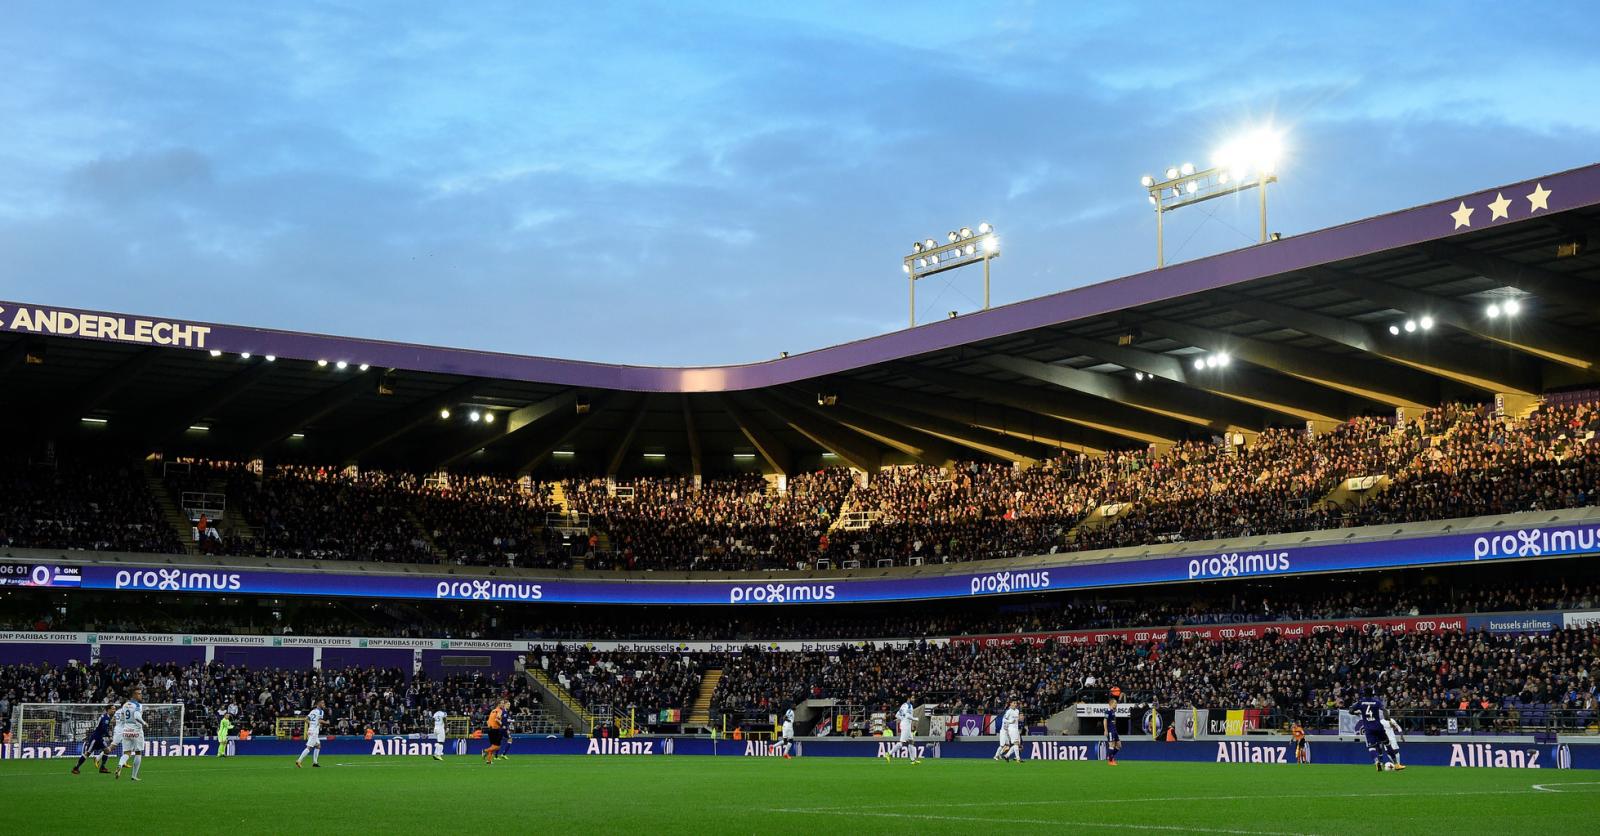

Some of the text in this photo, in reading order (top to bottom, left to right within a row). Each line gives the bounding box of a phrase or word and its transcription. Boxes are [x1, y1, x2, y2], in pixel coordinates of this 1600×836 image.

[10, 308, 210, 348] ANDERLECHT
[1188, 552, 1290, 579] proximus
[32, 566, 50, 585] 0
[115, 568, 240, 590] proximus
[971, 572, 1050, 595] proximus
[436, 580, 542, 600] proximus
[730, 584, 835, 604] proximus
[1238, 628, 1256, 636] Audi
[1284, 627, 1304, 635] Audi
[1439, 620, 1462, 630] Audi
[1490, 620, 1551, 630] brussels airlines
[1073, 635, 1088, 643] Audi
[126, 710, 130, 720] 9
[1366, 704, 1373, 719] 4
[0, 743, 66, 758] lianz
[144, 740, 210, 756] llianz
[372, 740, 443, 755] Allian
[587, 738, 653, 755] Allianz
[1030, 742, 1088, 760] Allianz
[1216, 742, 1288, 764] Allianz
[1450, 744, 1540, 768] Allianz
